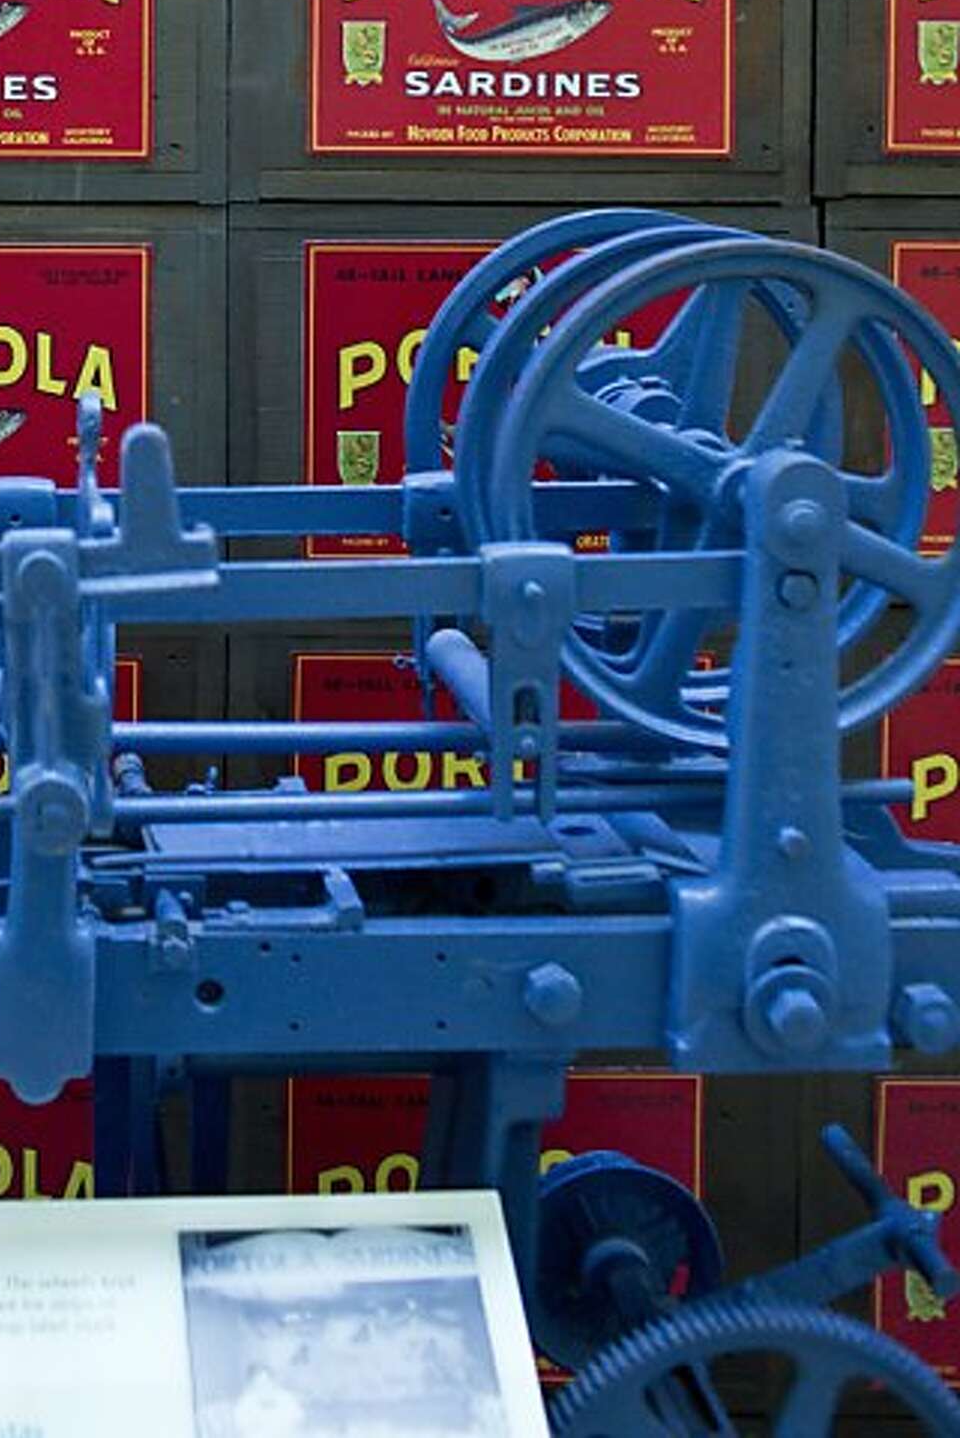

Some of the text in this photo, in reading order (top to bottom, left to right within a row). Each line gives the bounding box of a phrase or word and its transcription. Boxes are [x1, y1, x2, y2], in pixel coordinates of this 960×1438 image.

[404, 70, 641, 97] SARDINES
[457, 125, 489, 141] FOOD
[492, 125, 549, 141] PRODUCTS
[553, 125, 632, 141] CORPORATION
